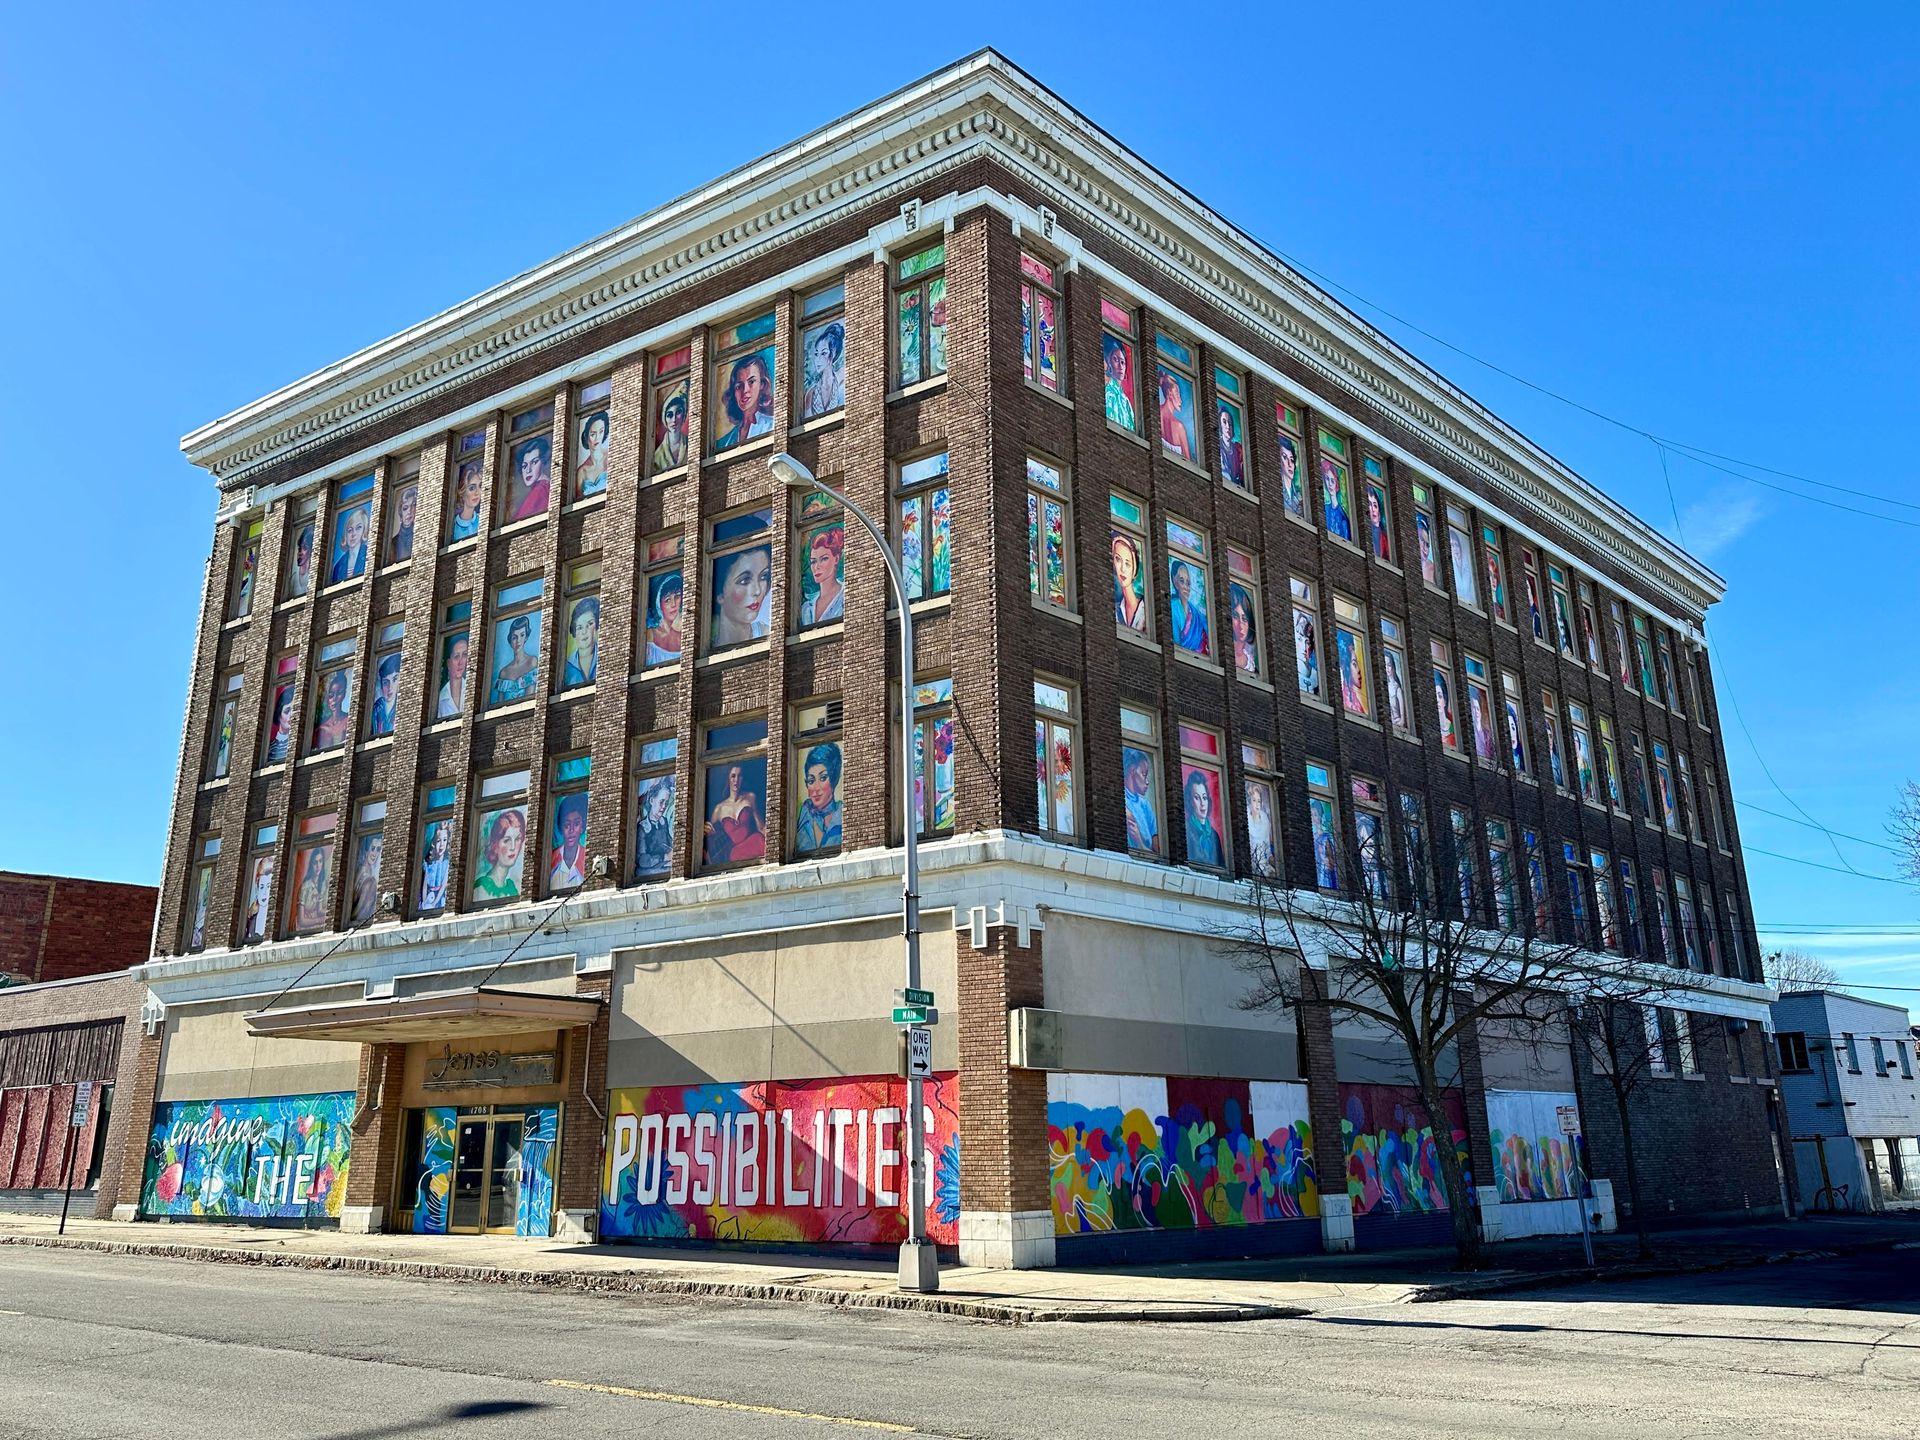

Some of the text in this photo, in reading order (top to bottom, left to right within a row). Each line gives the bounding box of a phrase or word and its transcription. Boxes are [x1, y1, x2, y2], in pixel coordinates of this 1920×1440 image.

[908, 991, 930, 1003] DIVISION
[902, 1010, 917, 1020] MAIN
[913, 1032, 929, 1044] ONE
[912, 1045, 930, 1058] WAY
[470, 1106, 487, 1114] 1708
[169, 1107, 265, 1161] imagine
[253, 1154, 313, 1205] THE
